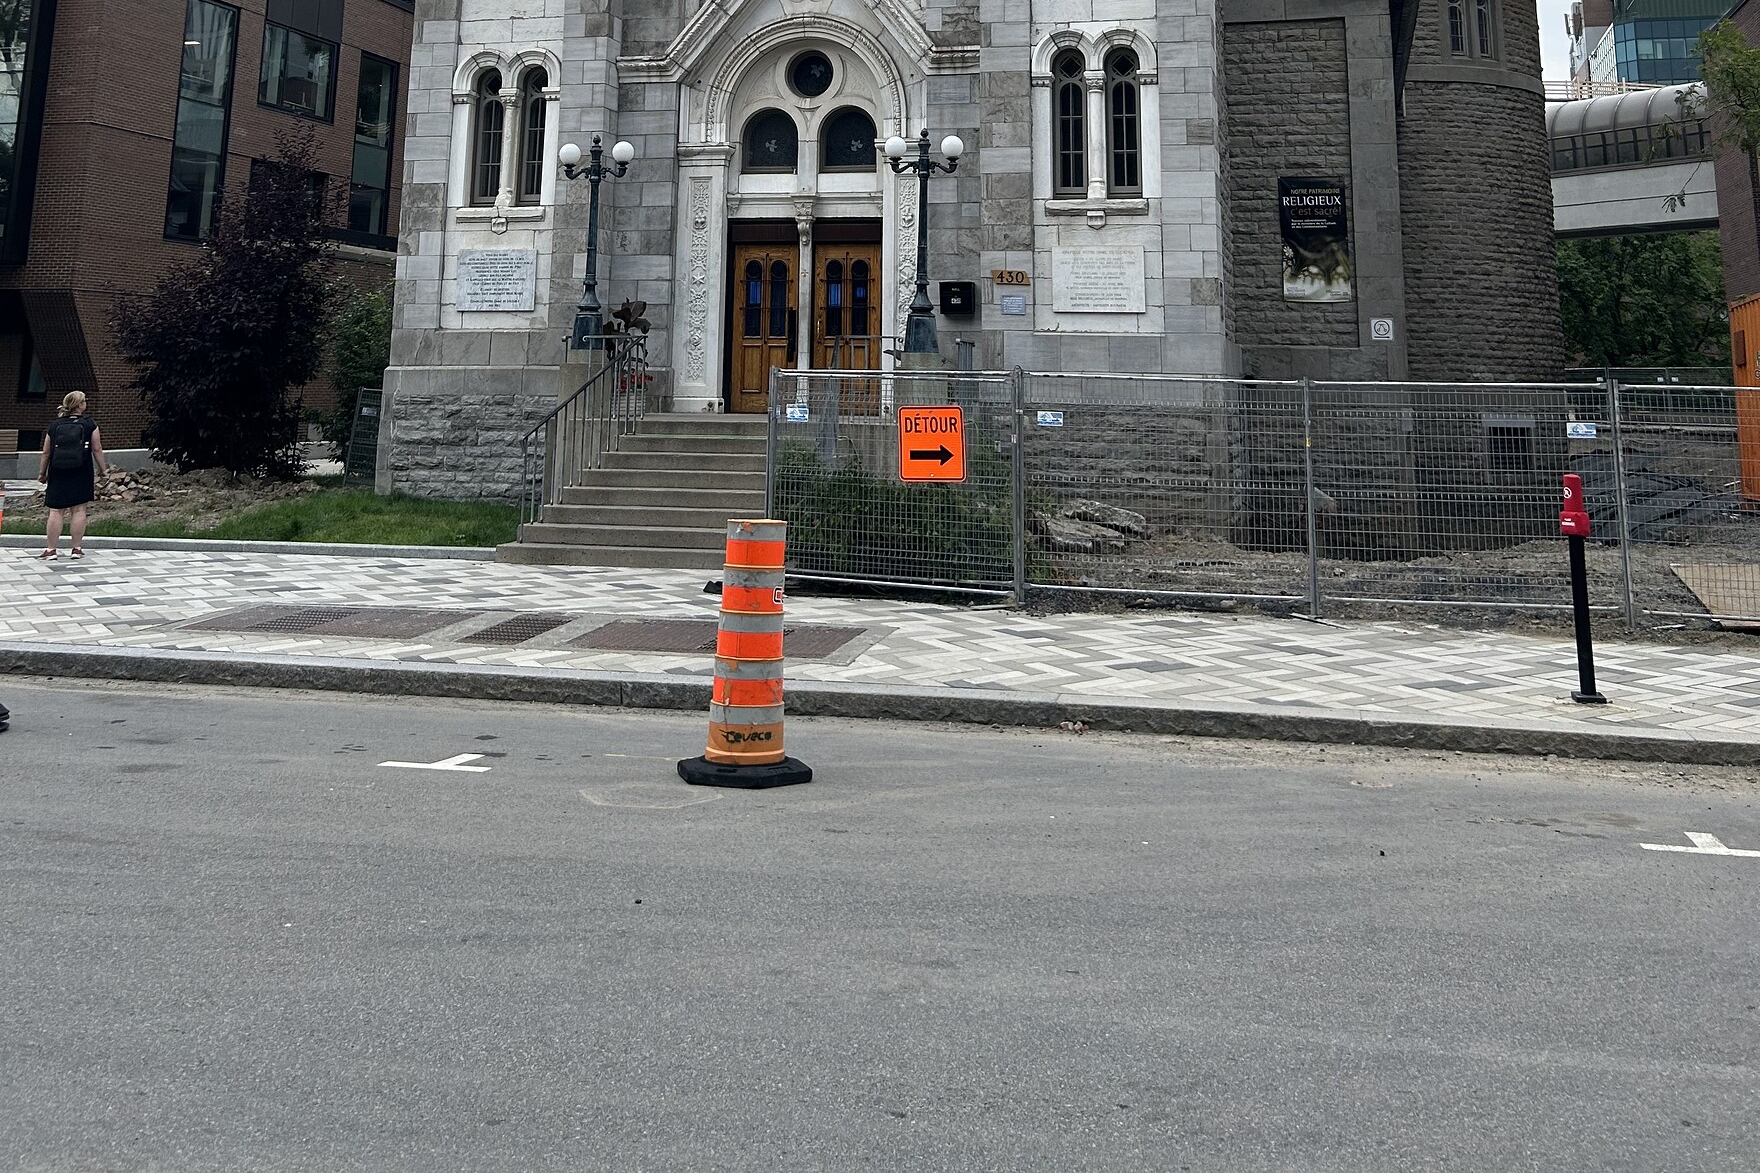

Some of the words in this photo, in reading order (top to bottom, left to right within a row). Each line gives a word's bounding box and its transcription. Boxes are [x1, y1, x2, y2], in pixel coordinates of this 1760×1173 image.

[1282, 195, 1341, 206] RELIGIEUX
[1290, 207, 1312, 216] c'est
[996, 271, 1024, 283] 430
[904, 413, 958, 433] DÉTOUR
